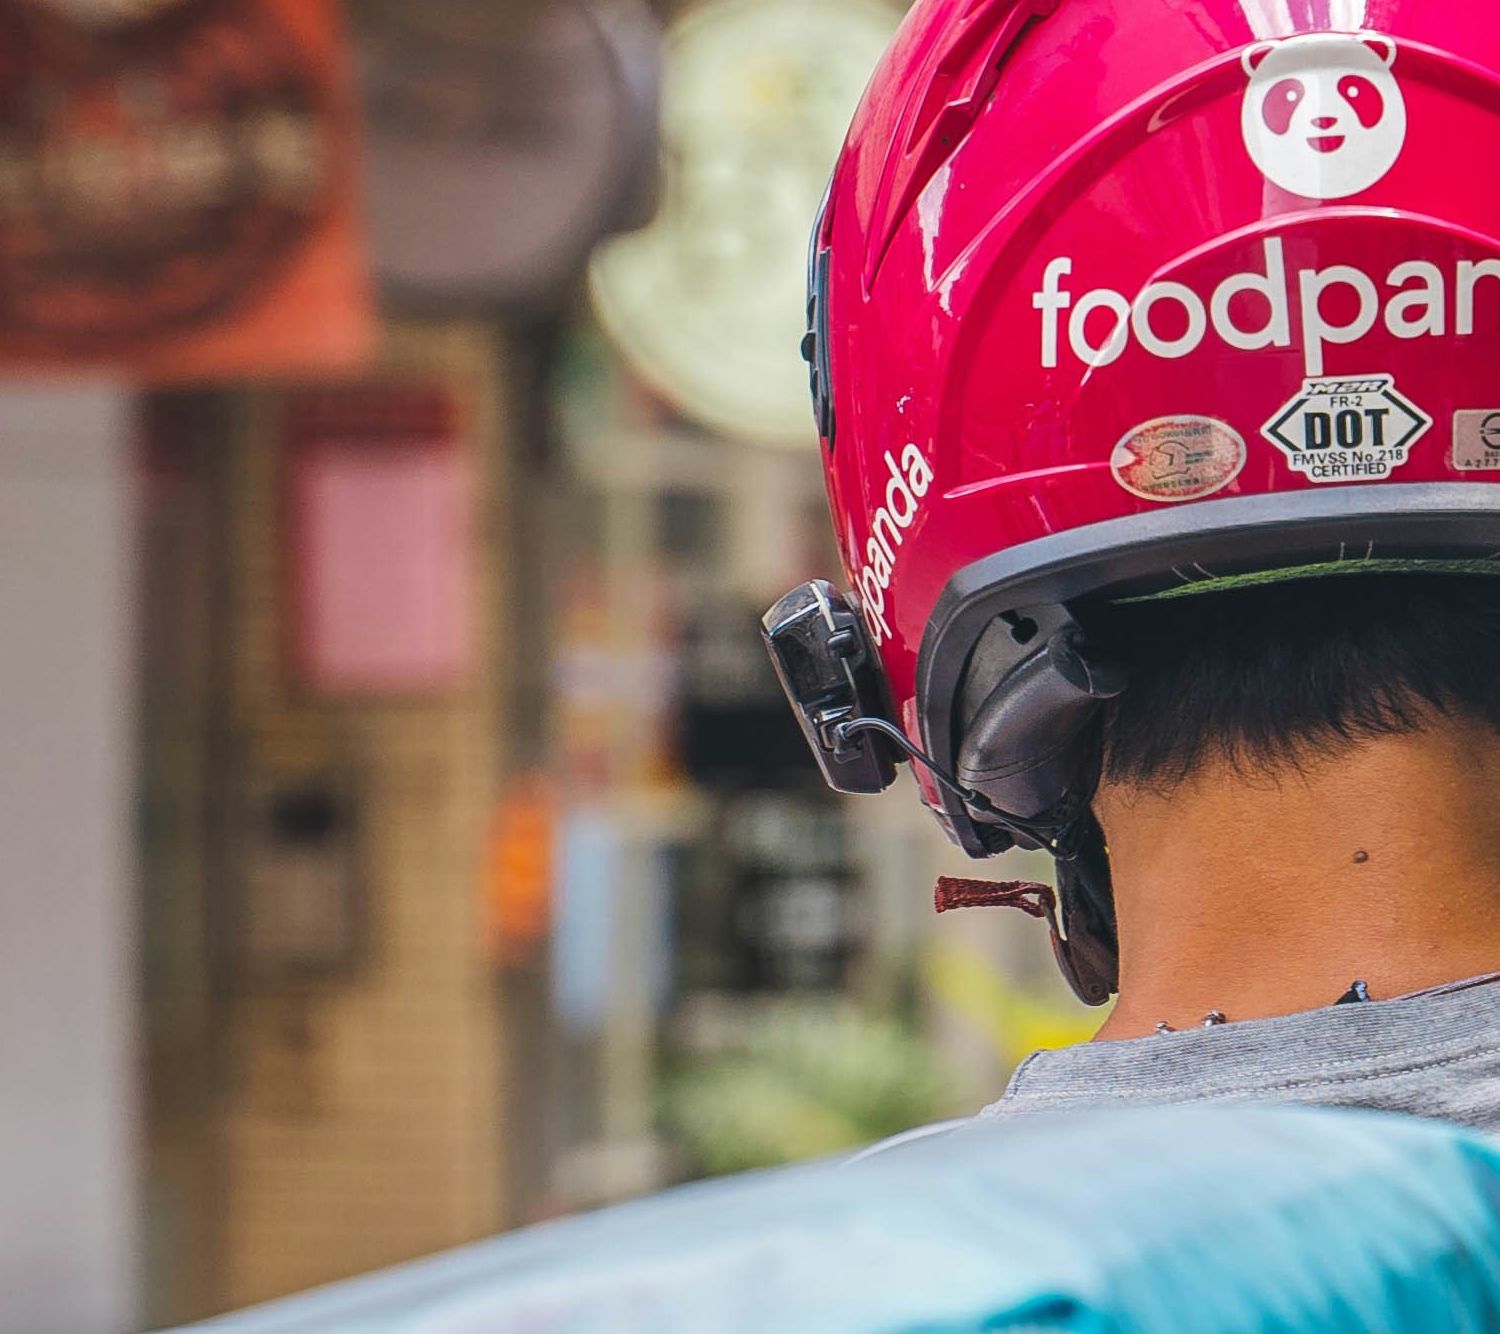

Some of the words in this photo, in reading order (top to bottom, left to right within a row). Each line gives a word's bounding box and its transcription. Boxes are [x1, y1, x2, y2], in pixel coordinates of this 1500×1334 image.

[1330, 396, 1363, 408] FR-2
[1304, 408, 1390, 450] DOT
[1293, 452, 1348, 466] FMVSS
[1312, 463, 1387, 477] CERTIFIED
